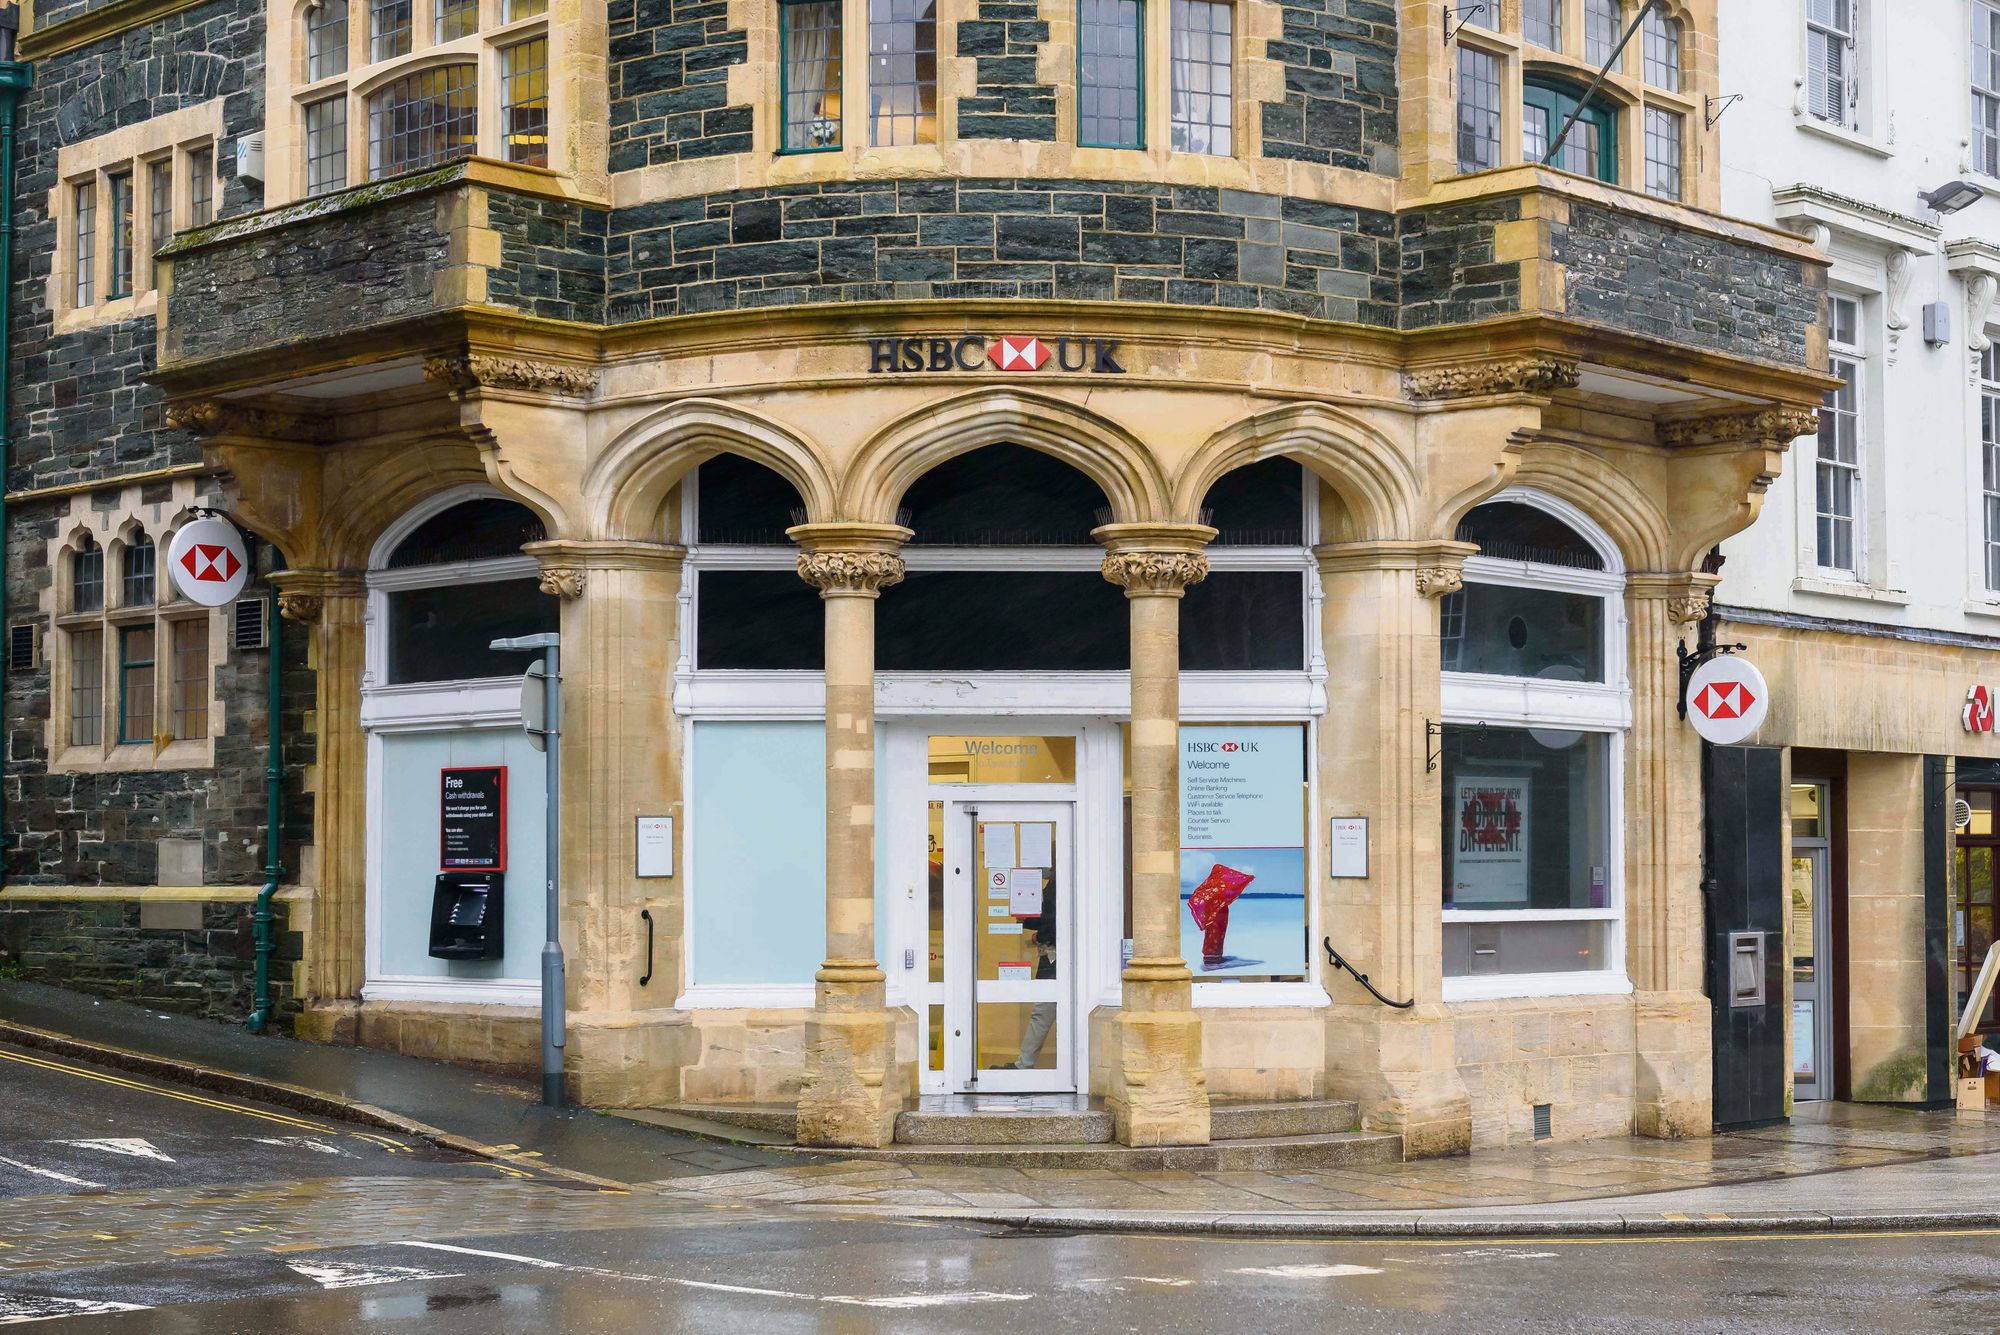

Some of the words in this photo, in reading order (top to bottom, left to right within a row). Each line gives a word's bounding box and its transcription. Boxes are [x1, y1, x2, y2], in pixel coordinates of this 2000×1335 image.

[867, 335, 985, 373] HSBC
[1056, 337, 1127, 373] UK
[965, 740, 1038, 756] Welcome
[1187, 742, 1219, 753] HSBC
[1241, 742, 1259, 753] UK
[1187, 760, 1230, 770] Welcome
[445, 776, 463, 788] Free
[445, 791, 458, 800] Cash
[458, 790, 485, 799] withdrawals
